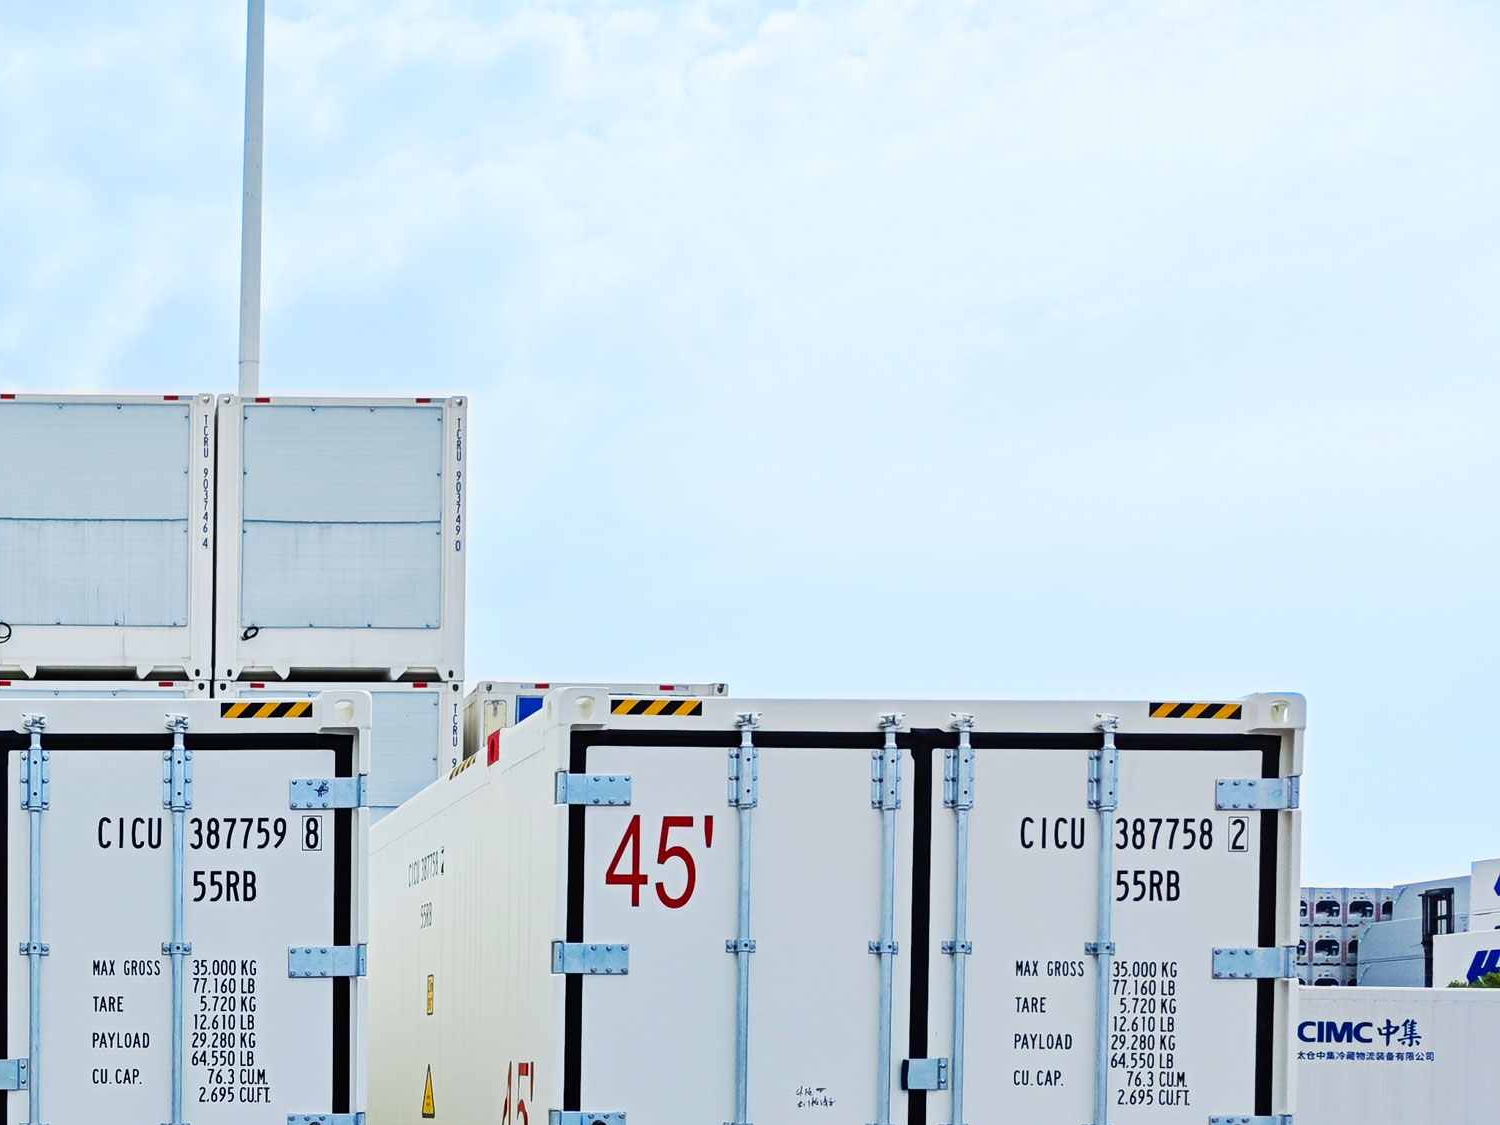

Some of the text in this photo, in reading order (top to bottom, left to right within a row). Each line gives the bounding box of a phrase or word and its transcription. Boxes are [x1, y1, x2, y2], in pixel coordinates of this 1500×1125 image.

[98, 817, 319, 849] CICU 387759 8
[1020, 817, 1245, 850] CICU 387758 2
[606, 816, 713, 908] 45'
[193, 871, 256, 902] 55RB
[1116, 870, 1180, 901] 55RB
[93, 960, 115, 976] MAX
[124, 960, 160, 976] GROSS
[241, 960, 256, 976] KG
[1016, 960, 1038, 976] MAX
[1047, 961, 1084, 977] GROSS
[1162, 962, 1177, 978] KG
[241, 978, 255, 994] LB
[1161, 980, 1175, 996] LB
[93, 996, 124, 1012] TARE
[241, 996, 256, 1012] KG
[1015, 997, 1046, 1013] TARE
[1161, 998, 1176, 1014] KG
[240, 1014, 254, 1030] LB
[1160, 1017, 1174, 1032] LB
[92, 1032, 149, 1048] PAYLOAD
[240, 1032, 255, 1048] KG
[1297, 1021, 1373, 1043] CIMC
[1377, 1018, 1422, 1047] 中集
[1014, 1034, 1072, 1050] PAYLOAD
[1160, 1035, 1175, 1051] KG
[240, 1050, 254, 1066] LB
[1160, 1053, 1173, 1069] LB
[207, 1069, 234, 1084] 76.3
[1127, 1071, 1153, 1087] 76.3
